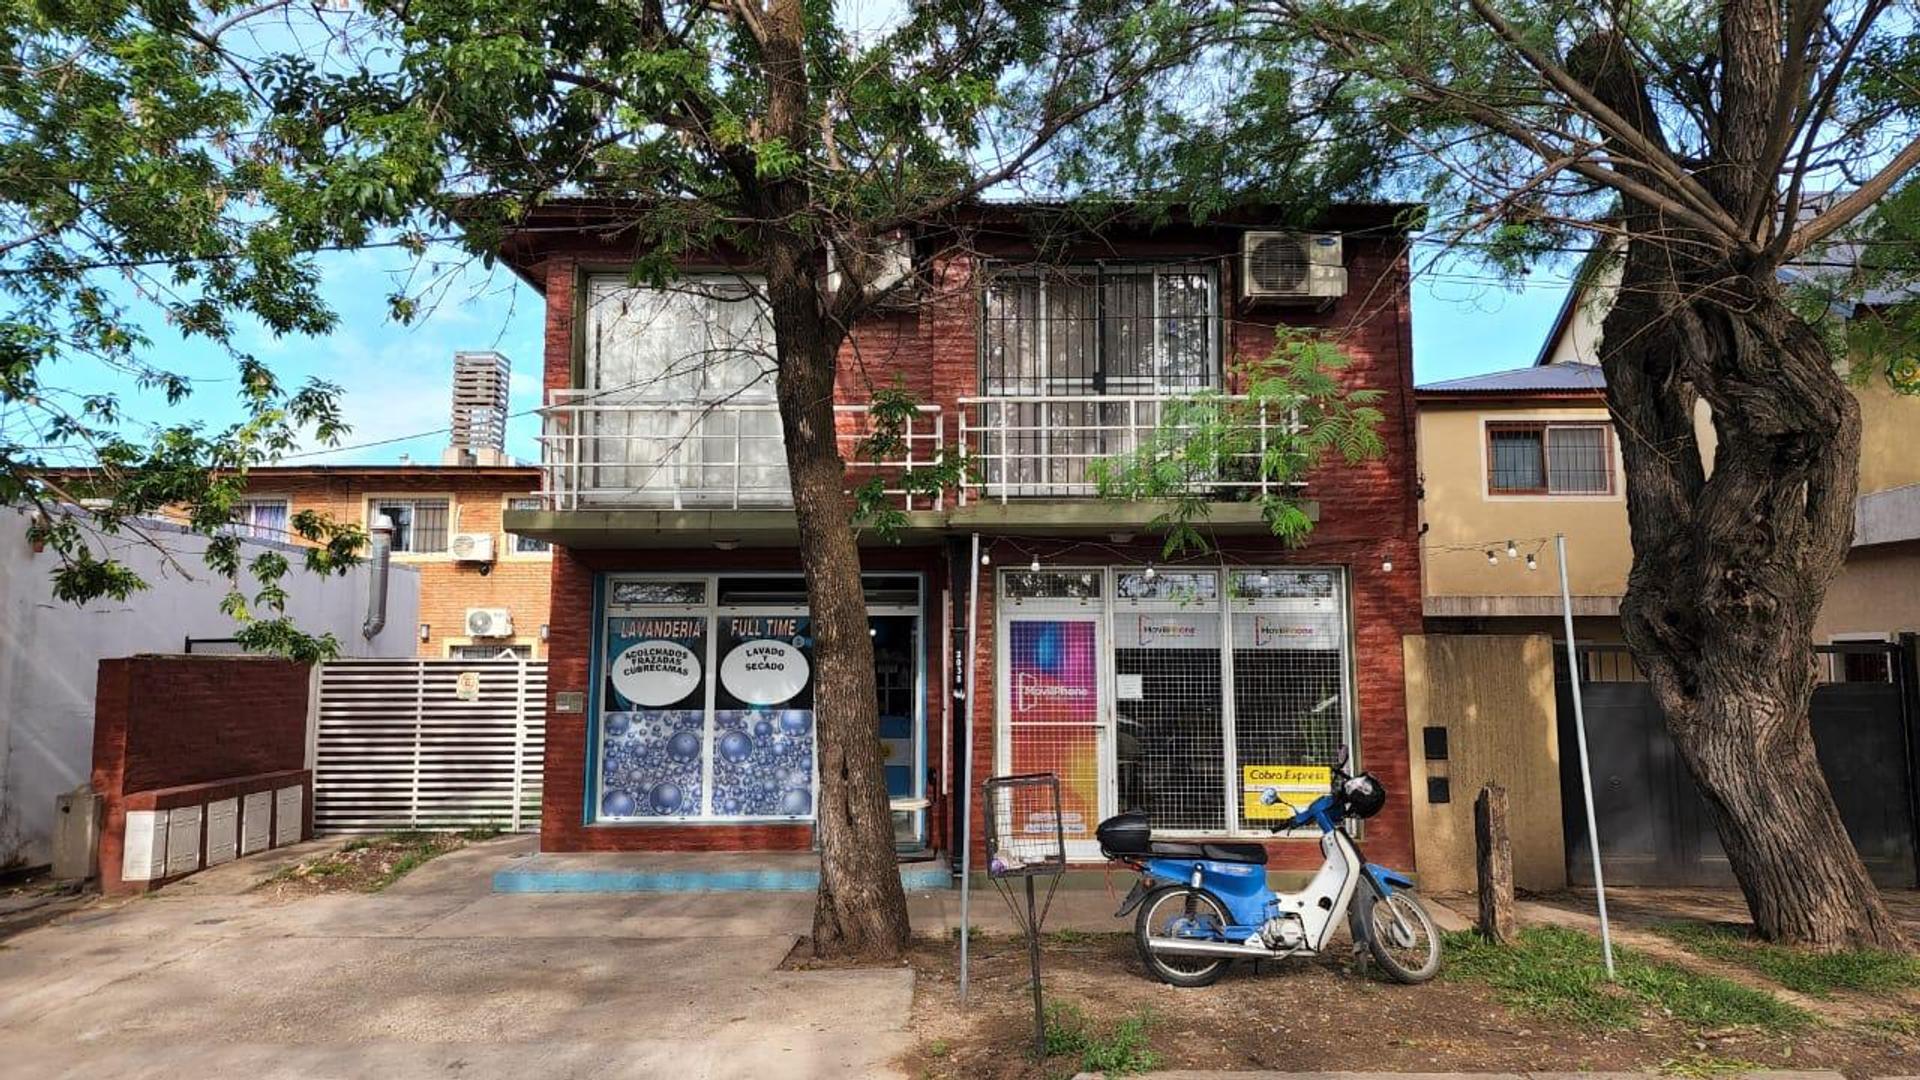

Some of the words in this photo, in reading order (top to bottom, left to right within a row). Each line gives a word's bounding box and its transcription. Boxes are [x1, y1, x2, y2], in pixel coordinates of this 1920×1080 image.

[621, 621, 701, 638] LAVANDERIA
[731, 619, 762, 636] FULL
[767, 619, 797, 636] TIME
[625, 648, 688, 660] ACOLCHADOS
[746, 648, 785, 657] LAVADO
[624, 664, 689, 676] CUBRECAMAS
[745, 662, 785, 671] SECADO
[1284, 769, 1325, 784] Express
